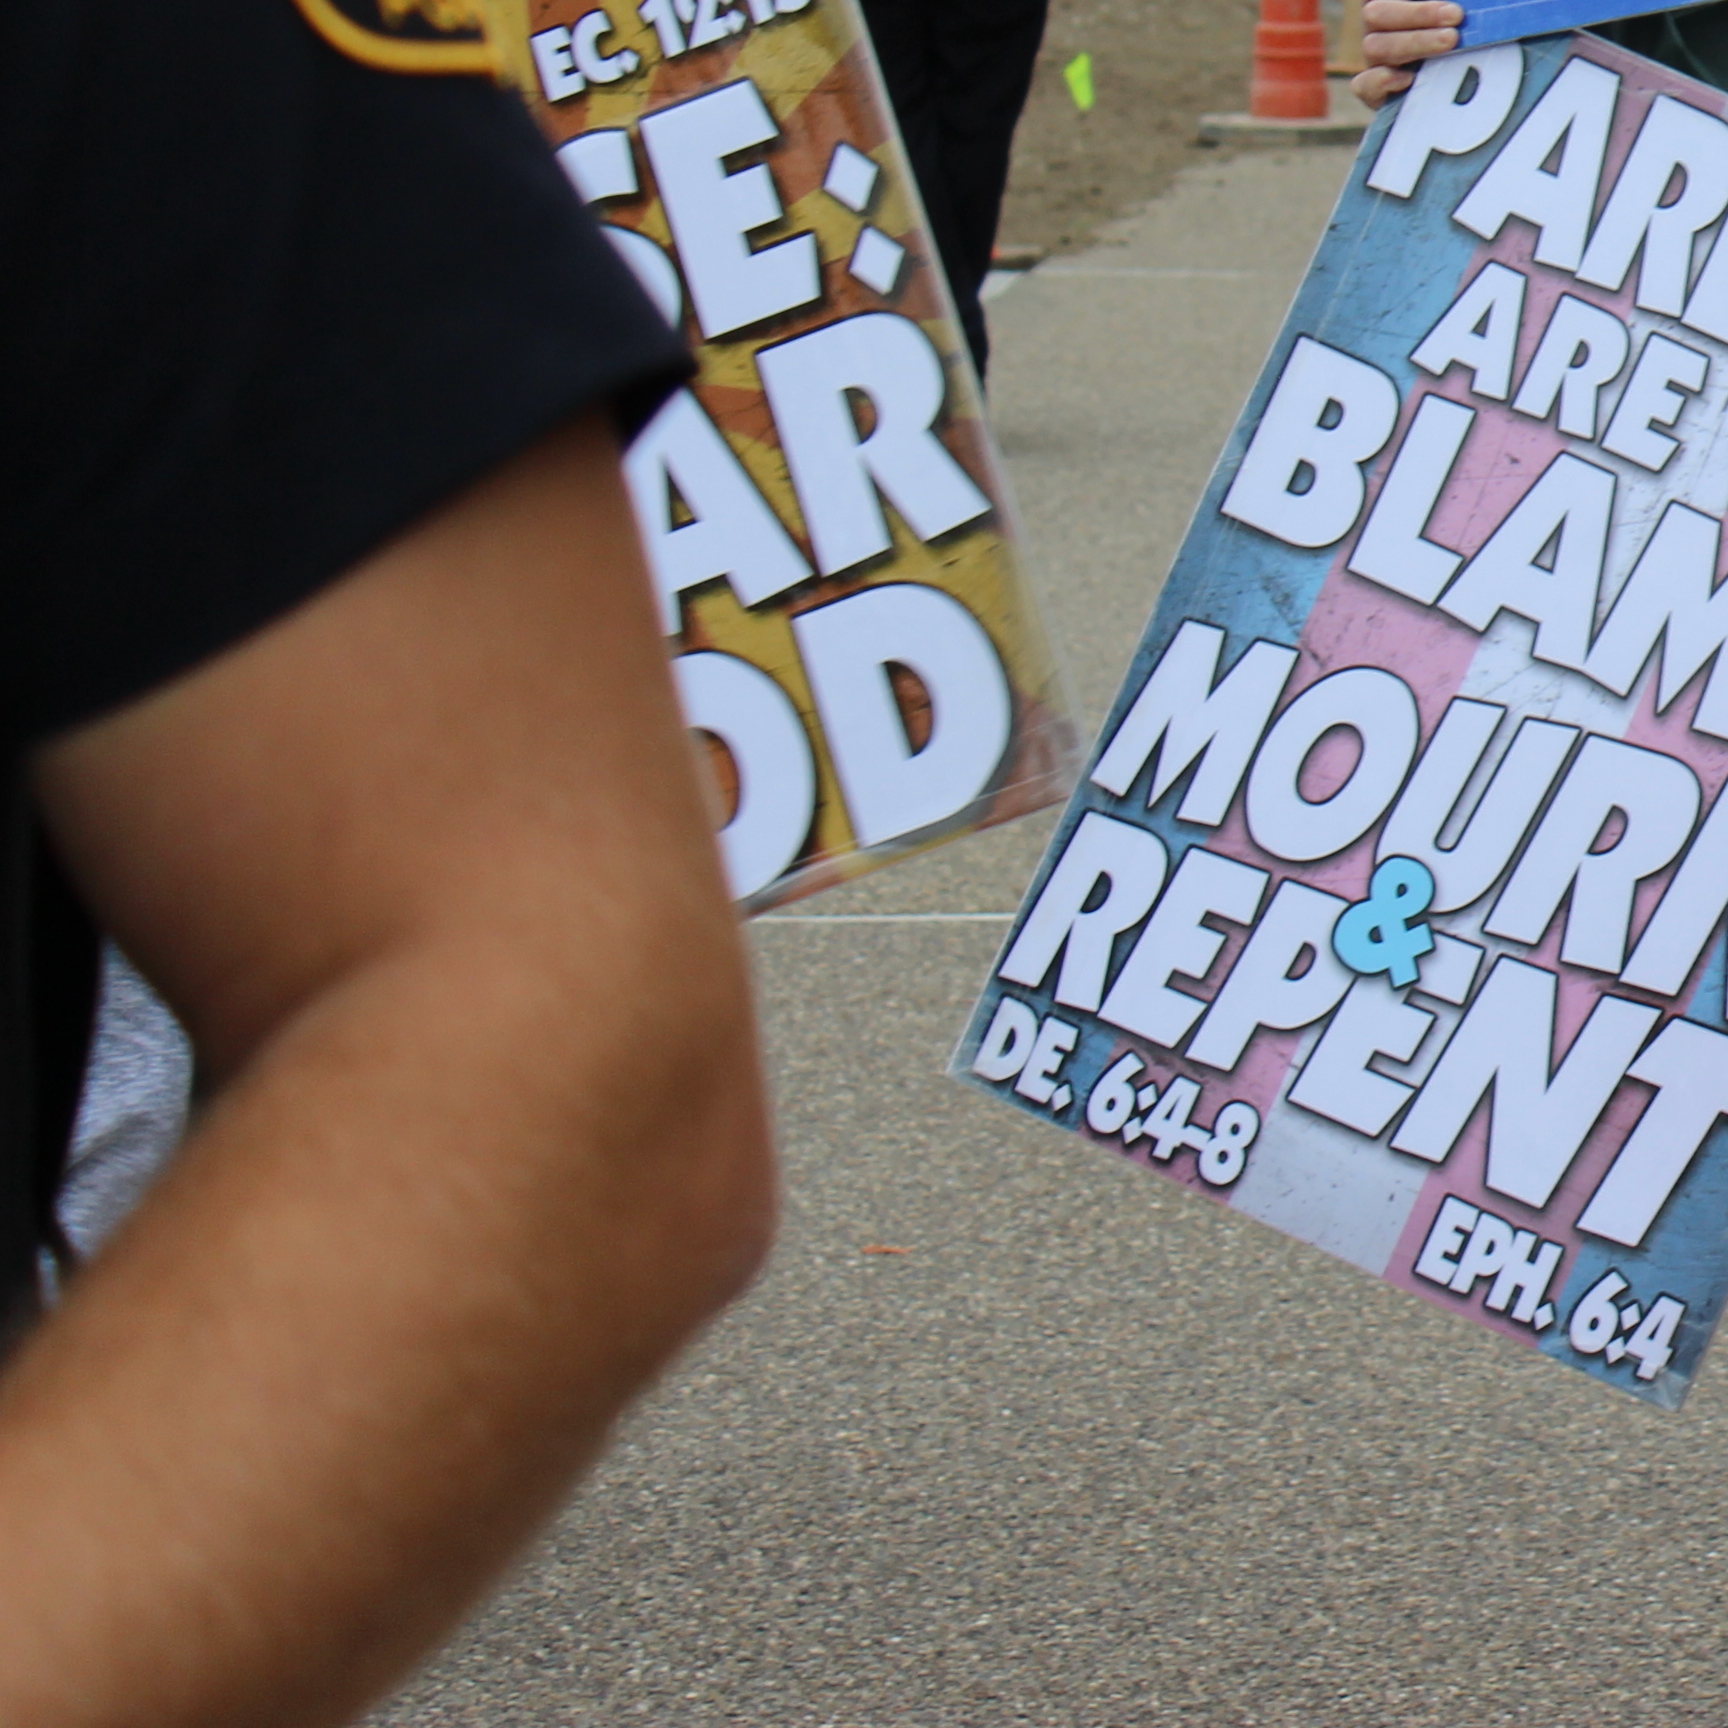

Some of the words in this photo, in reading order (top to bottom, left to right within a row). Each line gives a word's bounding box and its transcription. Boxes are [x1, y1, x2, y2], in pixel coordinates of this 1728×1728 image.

[530, 10, 640, 102] EC.
[1410, 259, 1709, 472] ARE
[1333, 854, 1436, 987] &
[973, 995, 1075, 1111] DE.
[1085, 1050, 1260, 1186] 6:4-8
[1413, 1195, 1562, 1327] EPH.
[1567, 1269, 1685, 1381] 6:4
